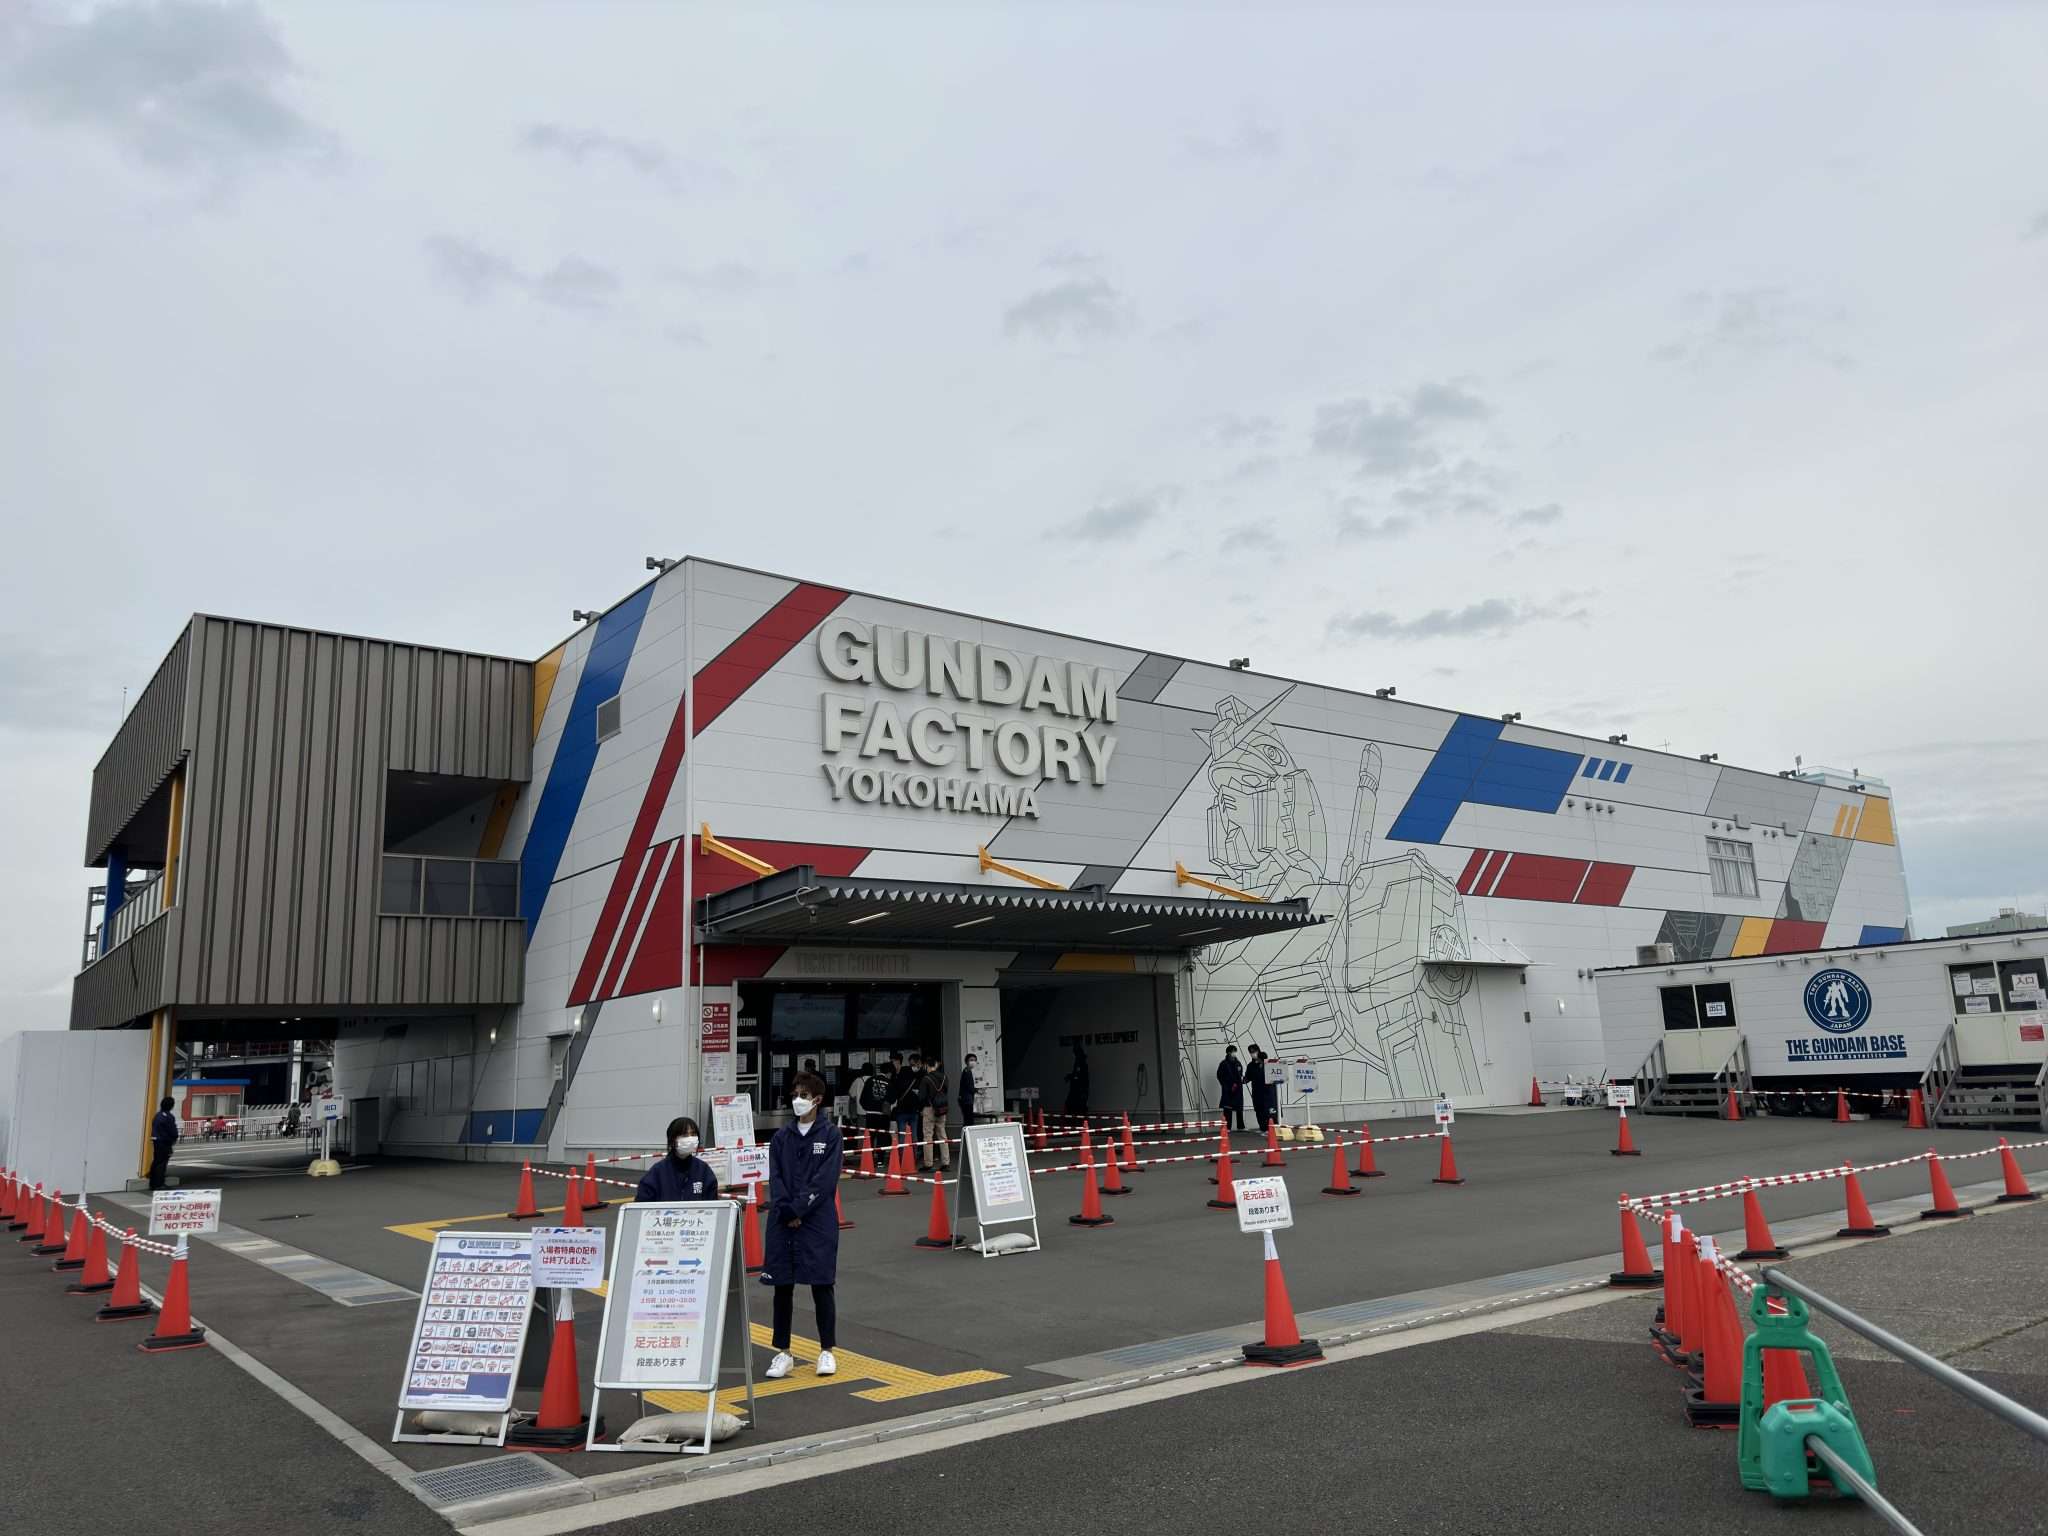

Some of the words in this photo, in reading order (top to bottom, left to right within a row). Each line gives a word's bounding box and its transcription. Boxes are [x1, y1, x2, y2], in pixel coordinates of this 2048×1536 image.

[816, 616, 1118, 723] GUNDAM
[821, 692, 1117, 785] FACTORY
[822, 763, 1040, 819] YOKOHAMA
[795, 952, 844, 974] TICKET
[1818, 974, 1846, 983] GUNDAM
[1847, 977, 1863, 992] BASE
[2016, 976, 2035, 985] 入口
[1785, 1039, 1810, 1055] THE
[1812, 1036, 1868, 1054] GUNDAM
[1870, 1034, 1906, 1052] BASE
[160, 1202, 211, 1211] ペットの同伴
[164, 1222, 178, 1230] NO
[181, 1221, 204, 1229] PETS
[653, 1217, 704, 1228] 入場チケット
[539, 1245, 597, 1255] 入場者特典の配布
[542, 1257, 591, 1265] は終了しました。
[636, 1358, 687, 1368] 段差あります
